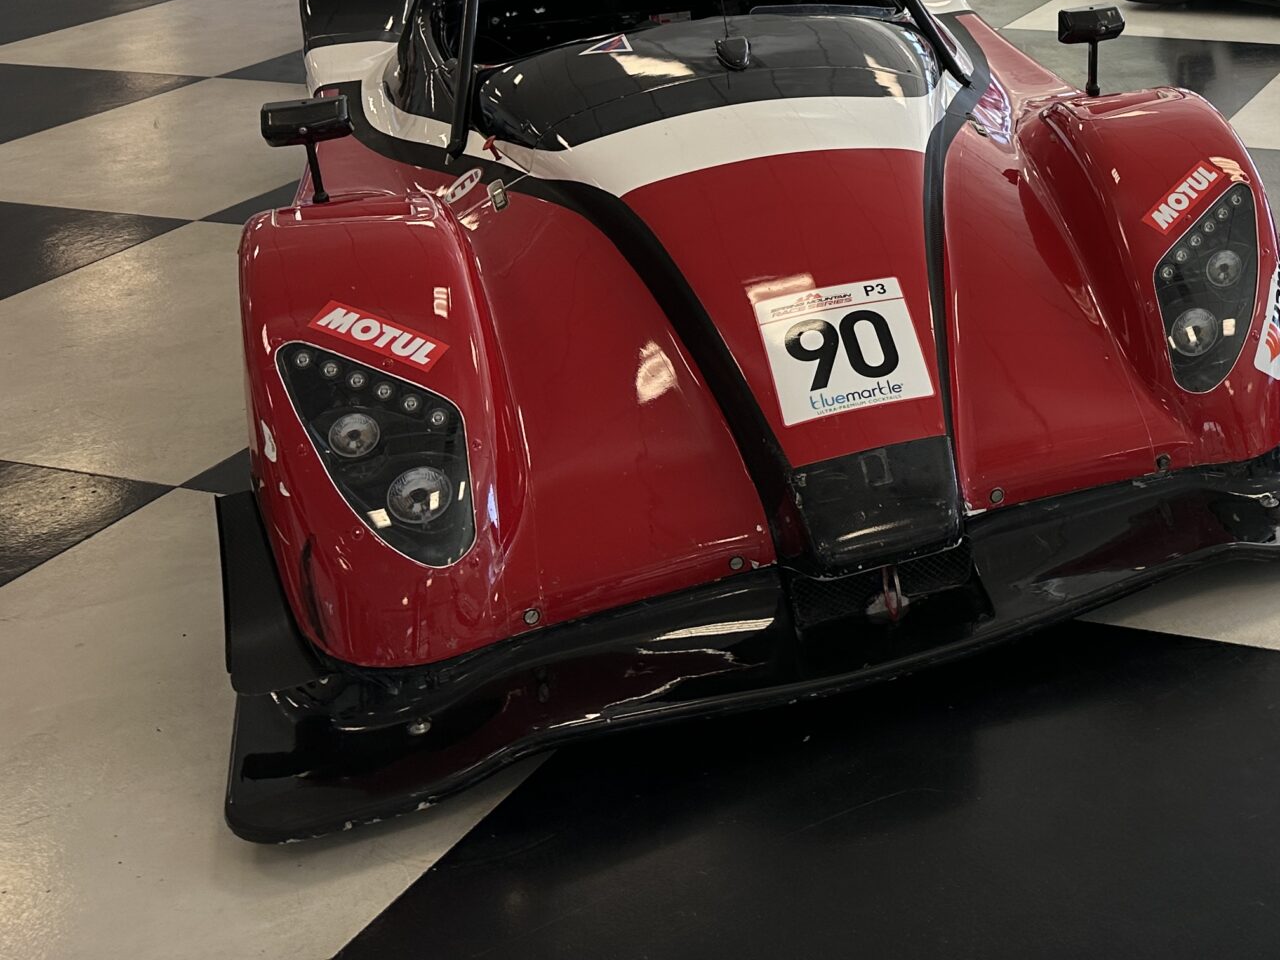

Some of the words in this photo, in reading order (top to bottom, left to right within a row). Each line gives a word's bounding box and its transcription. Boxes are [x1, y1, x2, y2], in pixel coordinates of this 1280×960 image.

[1151, 166, 1219, 230] MOTUL
[863, 284, 887, 297] P3
[770, 302, 805, 314] SPRING
[806, 293, 852, 305] MOUNTAIN
[772, 306, 806, 318] RACE
[807, 297, 853, 309] SERIES
[317, 307, 437, 365] MOTUL
[785, 310, 899, 392] 90
[816, 400, 867, 415] ULTRA-PREMIUM
[868, 394, 902, 404] COCKTAILS
